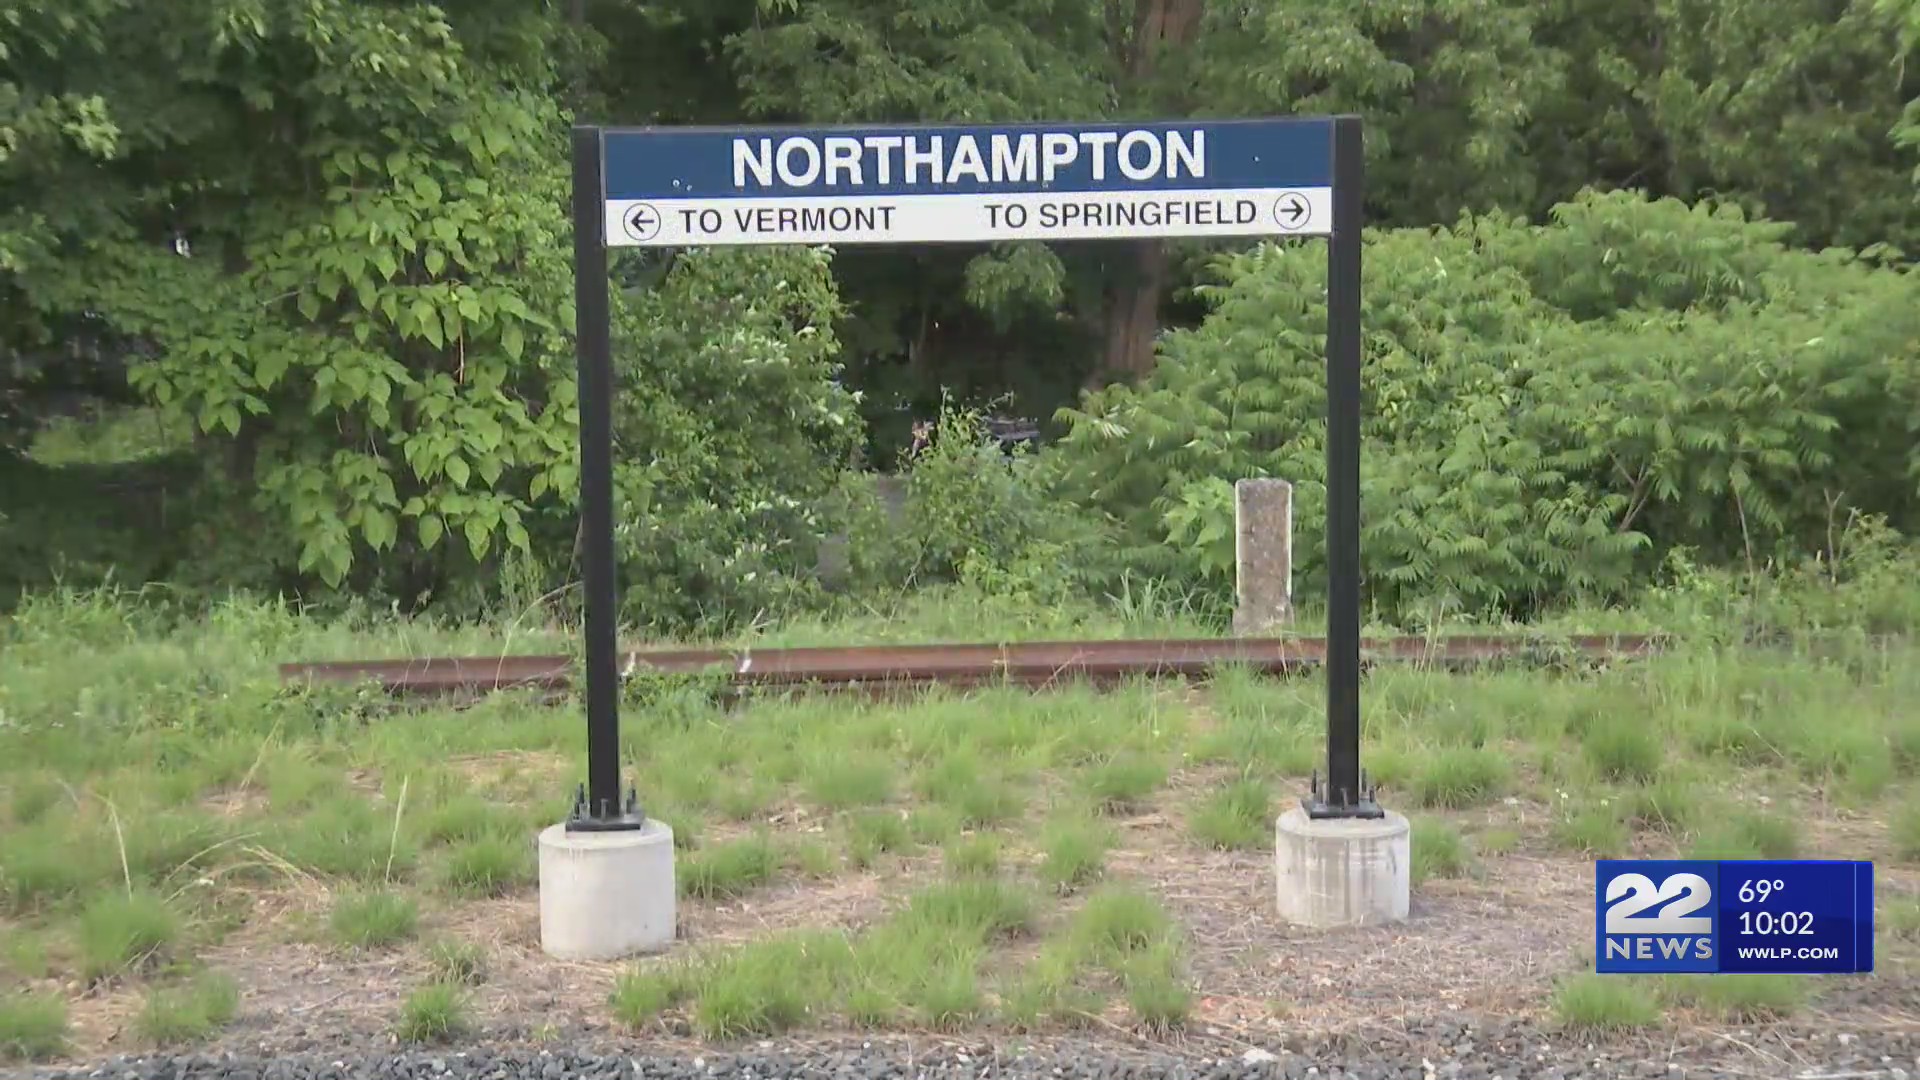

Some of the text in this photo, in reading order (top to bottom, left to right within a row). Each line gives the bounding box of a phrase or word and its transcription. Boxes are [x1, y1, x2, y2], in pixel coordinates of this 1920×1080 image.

[733, 130, 1205, 187] NORTHAMPTON
[679, 206, 896, 233] TO VERMONT
[985, 199, 1257, 228] TO SPRINGFIELD
